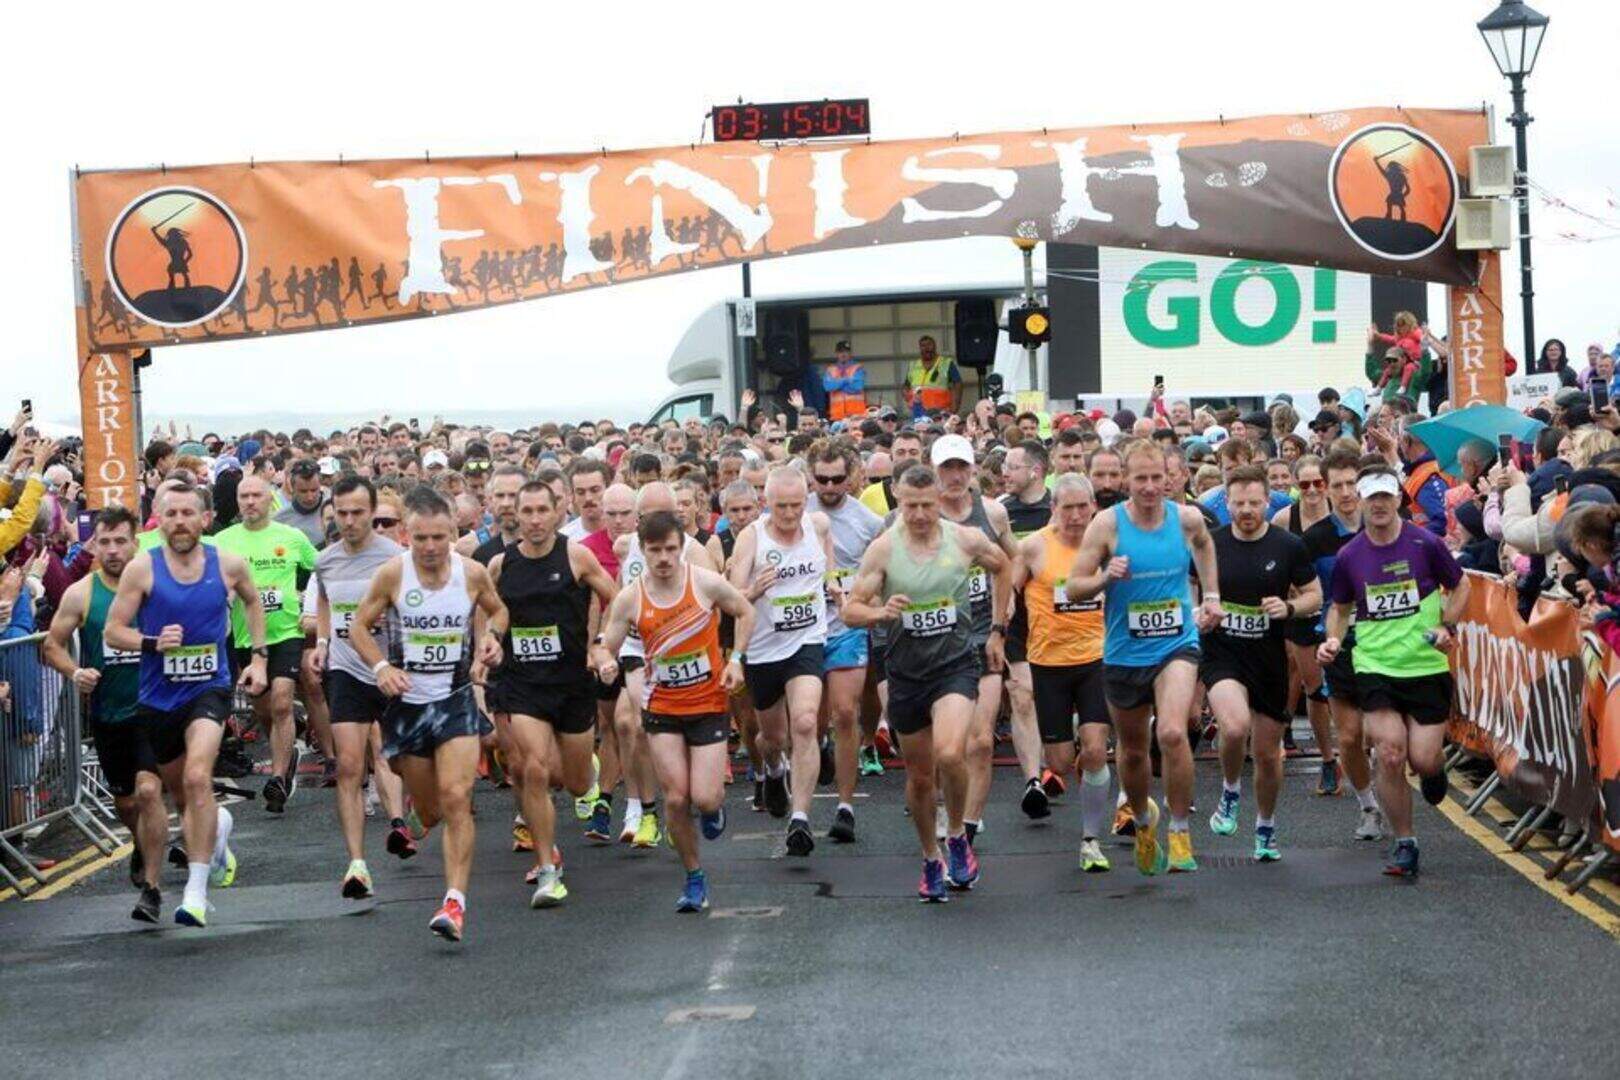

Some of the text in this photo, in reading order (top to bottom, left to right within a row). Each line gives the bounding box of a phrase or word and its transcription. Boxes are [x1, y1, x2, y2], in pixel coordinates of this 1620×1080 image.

[717, 103, 865, 139] 03:15:04
[373, 131, 1200, 305] FINISH
[1122, 259, 1337, 348] GO!
[1459, 258, 1487, 405] ARRI
[1375, 591, 1410, 610] 274
[783, 603, 813, 620] 596
[912, 608, 948, 628] 856
[1138, 610, 1174, 628] 605
[402, 615, 439, 629] SLIGO
[1225, 612, 1266, 631] 1184
[423, 645, 447, 662] 50
[520, 637, 553, 654] 816
[168, 656, 214, 673] 1146
[668, 660, 700, 679] 511
